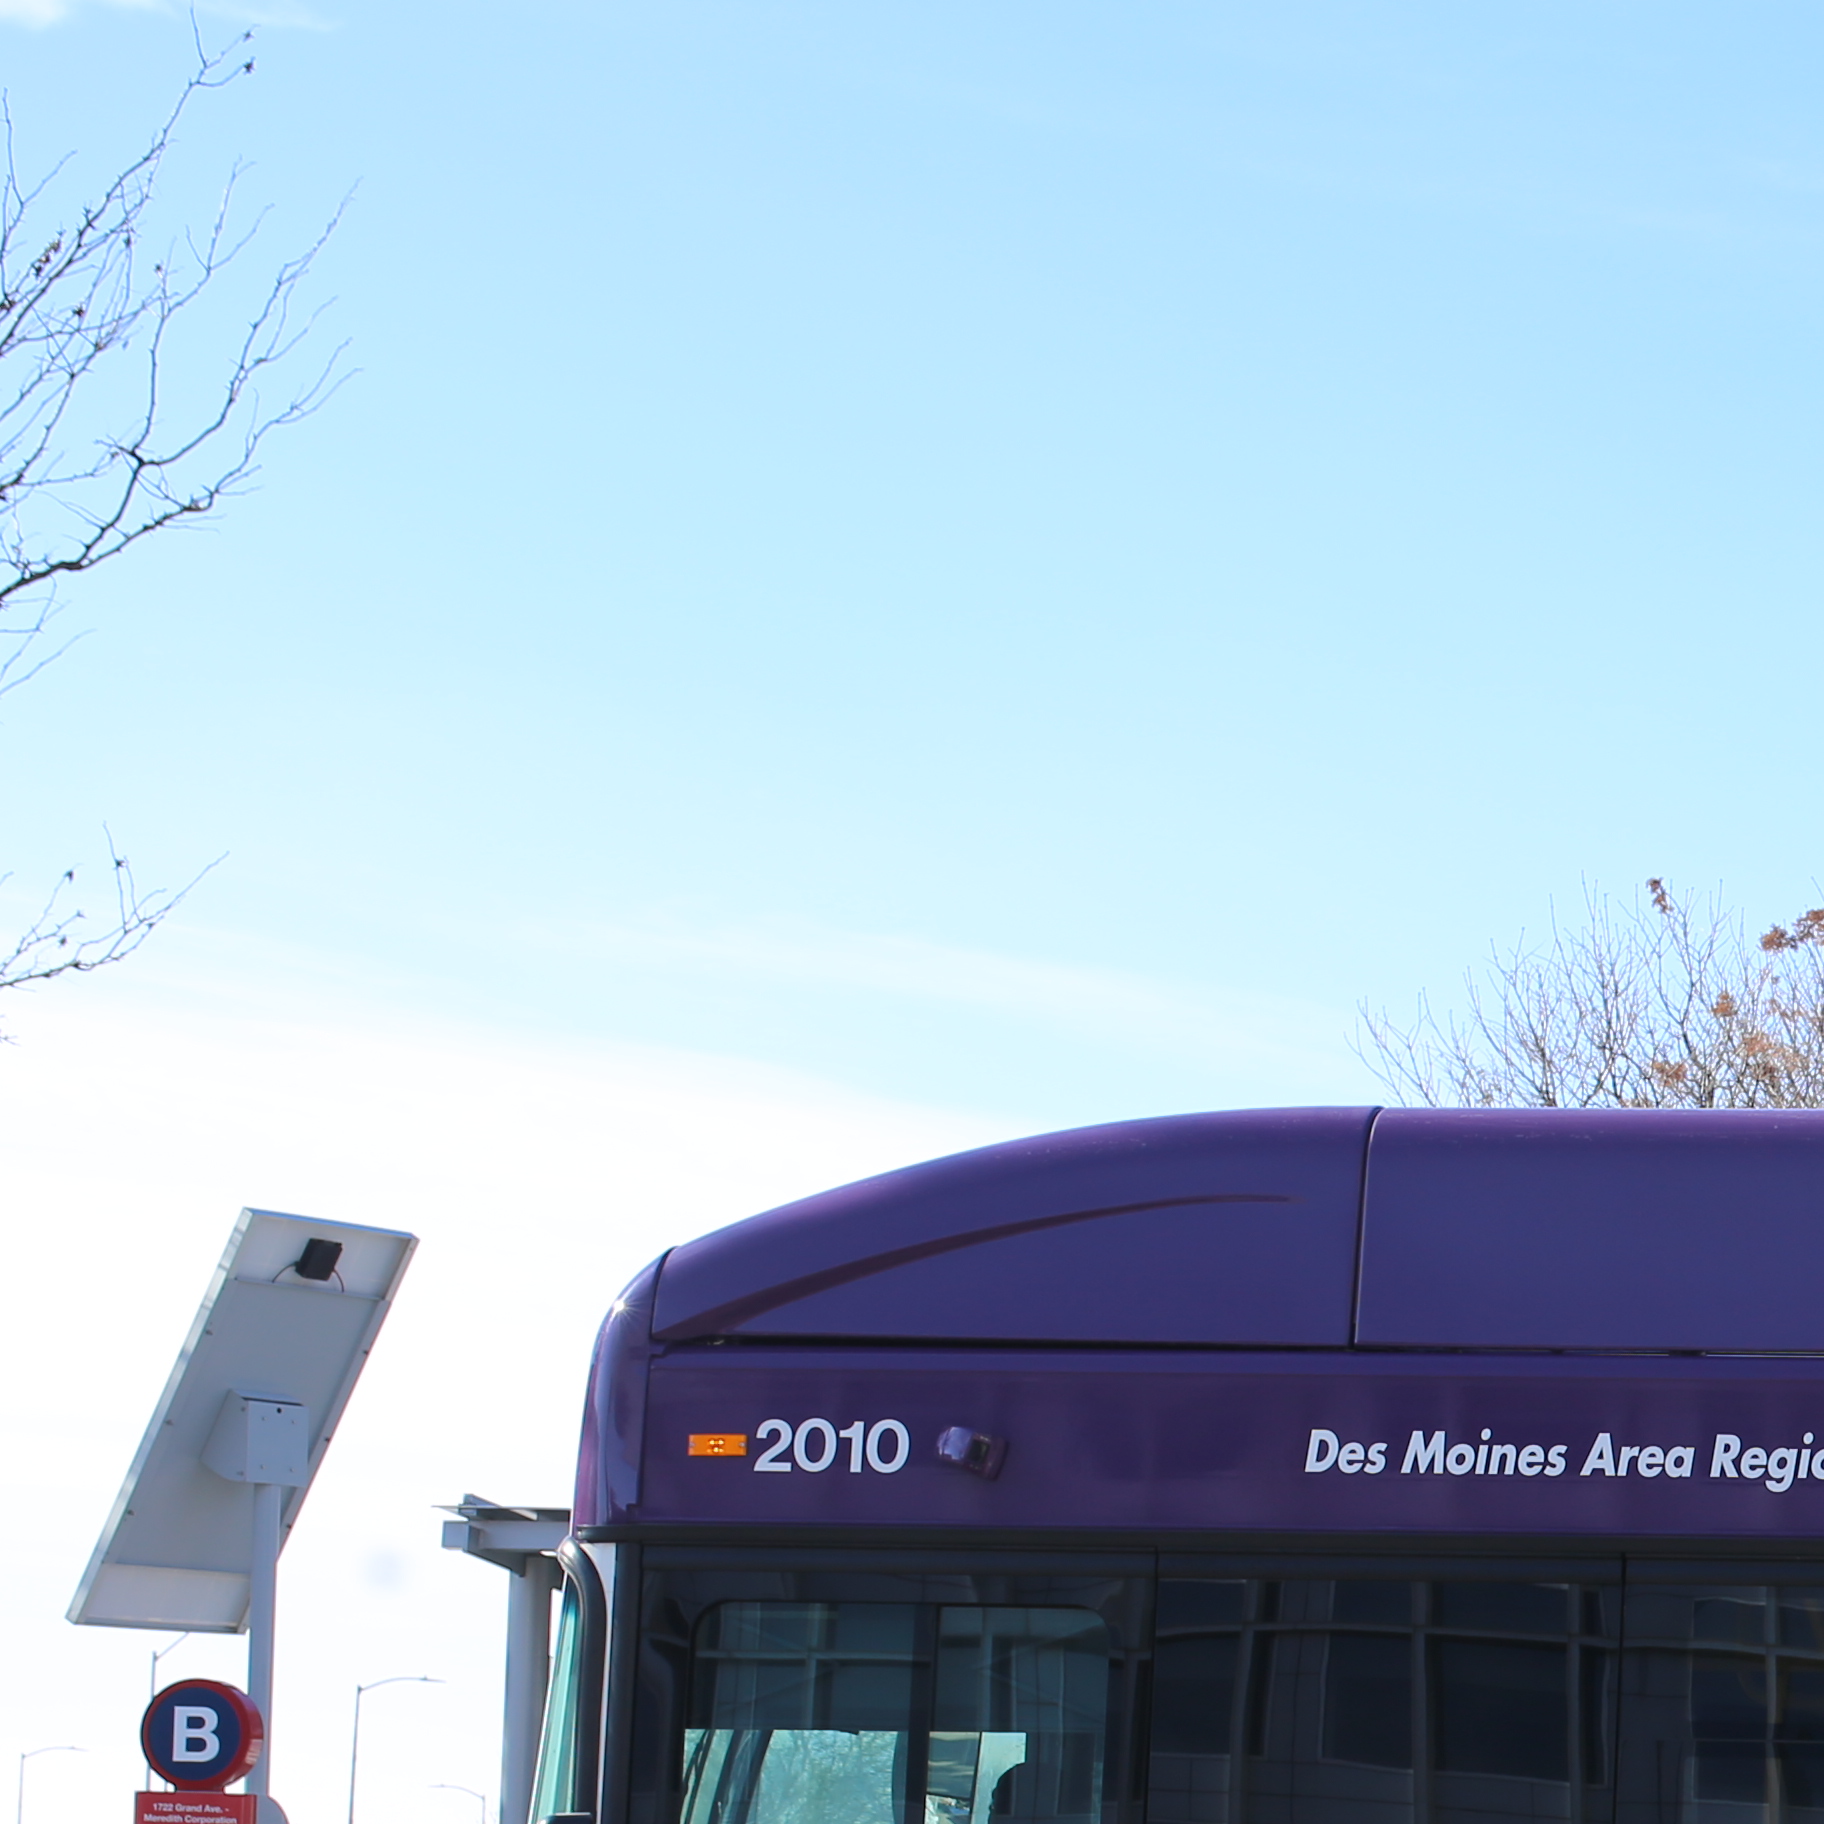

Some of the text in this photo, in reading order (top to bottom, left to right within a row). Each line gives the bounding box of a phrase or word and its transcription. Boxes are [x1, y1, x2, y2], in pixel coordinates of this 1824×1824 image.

[752, 1417, 911, 1475] 2010
[1304, 1428, 1388, 1475] Des
[1400, 1427, 1568, 1477] Moines
[1579, 1432, 1696, 1478] Area
[172, 1705, 221, 1762] B
[143, 1813, 238, 1824] Meredith Corporation
[153, 1803, 174, 1812] 1722
[175, 1803, 202, 1813] Grand
